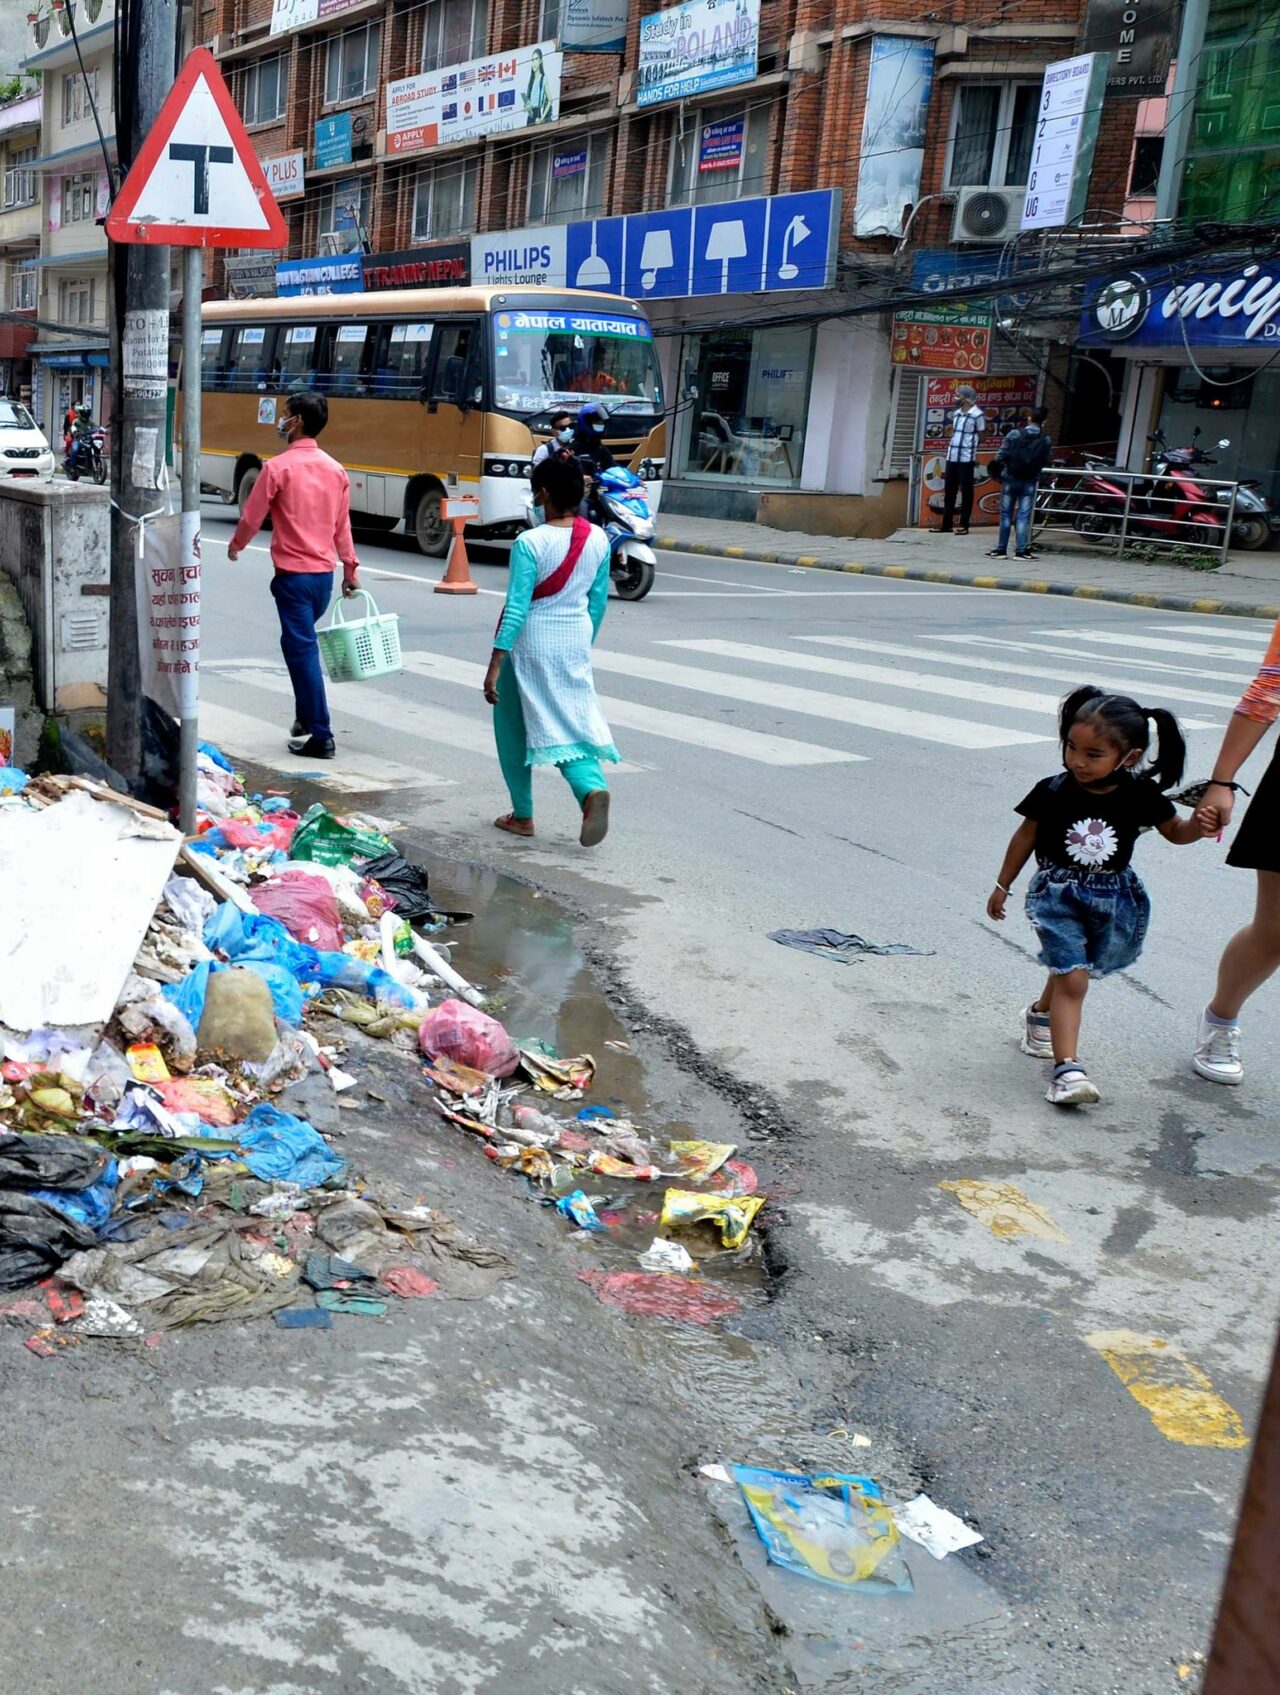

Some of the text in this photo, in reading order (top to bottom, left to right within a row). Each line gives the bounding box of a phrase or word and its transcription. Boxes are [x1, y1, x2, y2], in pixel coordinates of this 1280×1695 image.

[272, 11, 313, 32] GLOBAL
[644, 12, 692, 40] Study in
[676, 17, 753, 60] POLAND
[1045, 63, 1090, 85] DIRECTORY BOARD
[1128, 76, 1145, 85] PVT.
[392, 85, 405, 93] APPLY
[392, 86, 437, 105] ABROAD STUDY
[638, 87, 663, 102] HANDS
[664, 83, 680, 97] FOR
[680, 78, 700, 95] HELP
[1043, 90, 1051, 111] 3
[402, 129, 424, 140] APPLY
[1038, 117, 1047, 138] 2
[1036, 144, 1042, 165] 1
[273, 160, 297, 182] PLUS
[1030, 171, 1038, 191] G
[1025, 197, 1039, 217] UG
[484, 245, 551, 273] PHILIPS
[321, 263, 359, 281] COLLEGE
[374, 262, 426, 287] TRAINING
[429, 257, 466, 281] NEPAL
[488, 272, 547, 286] Lights Lounge
[514, 312, 637, 336] नेपाल यातायात
[712, 372, 730, 383] OFFICE
